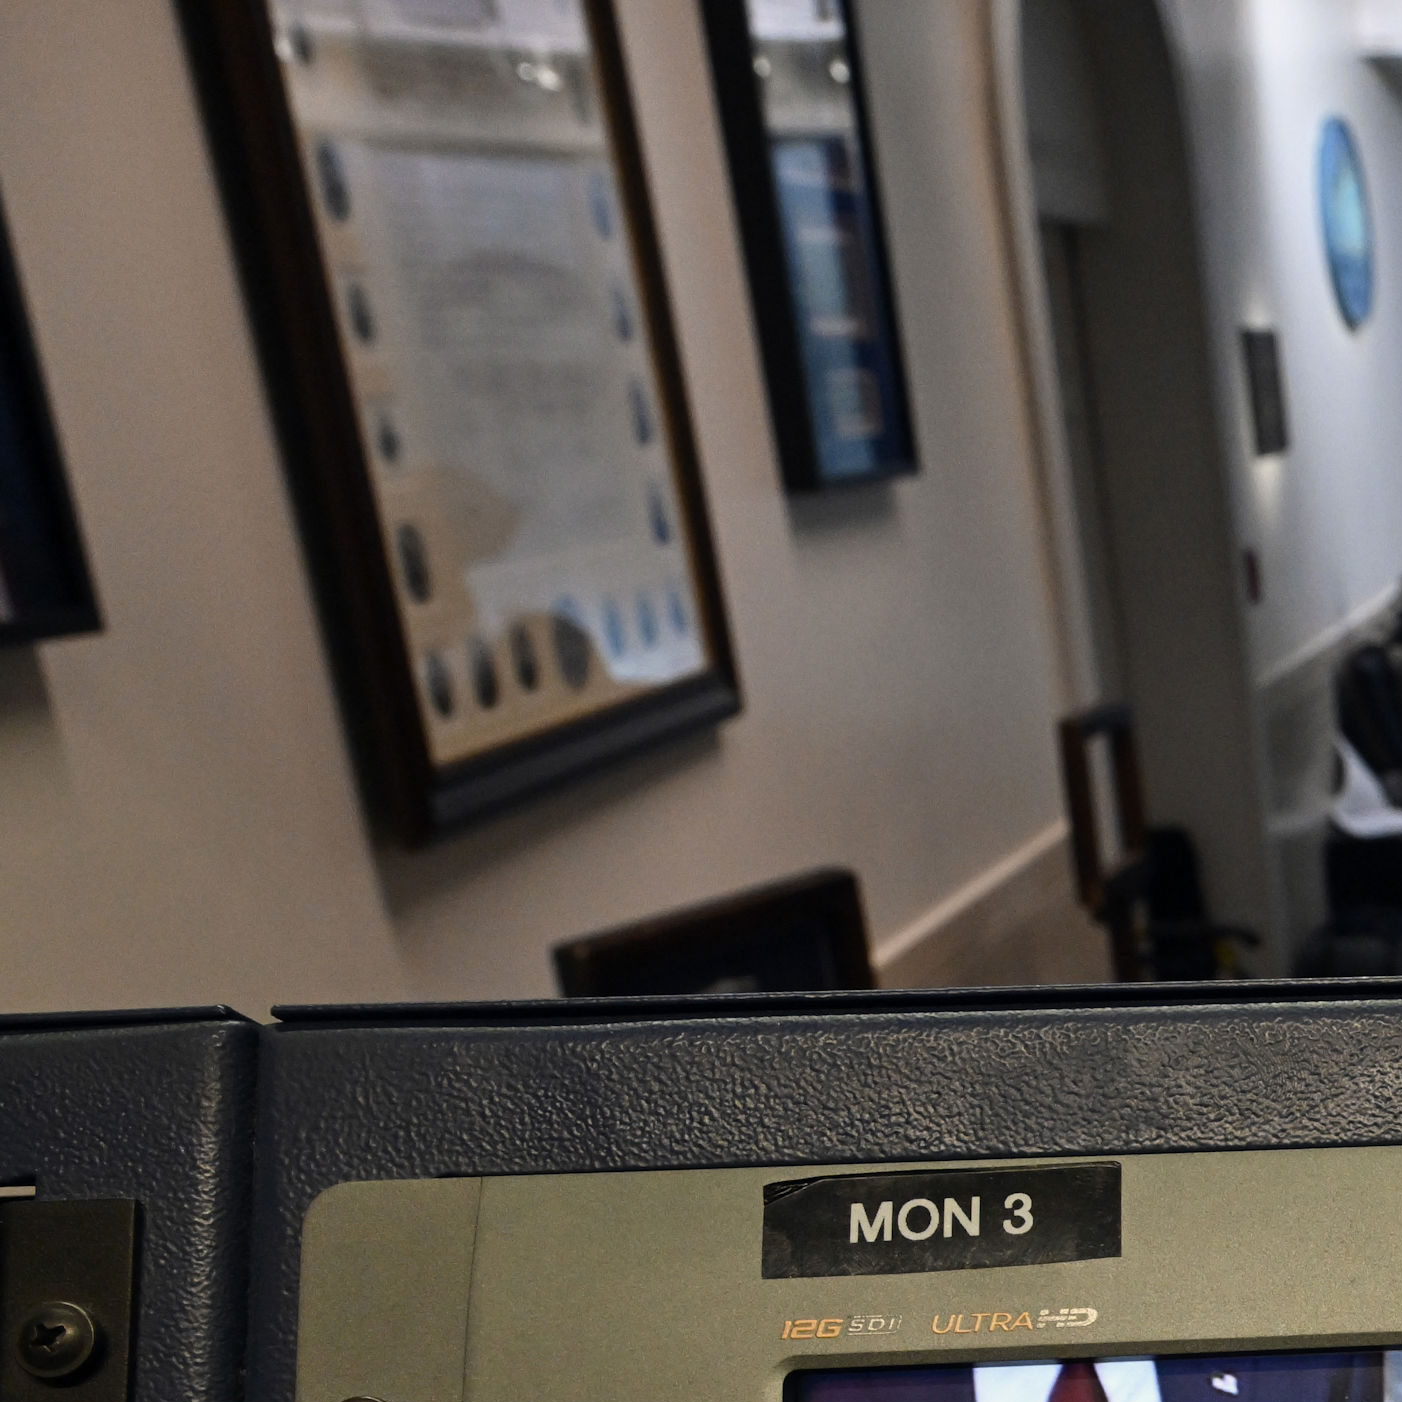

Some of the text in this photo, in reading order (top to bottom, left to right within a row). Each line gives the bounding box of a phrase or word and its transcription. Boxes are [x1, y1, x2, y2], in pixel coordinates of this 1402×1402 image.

[849, 1192, 1034, 1244] MON 3
[781, 1318, 844, 1340] 12G
